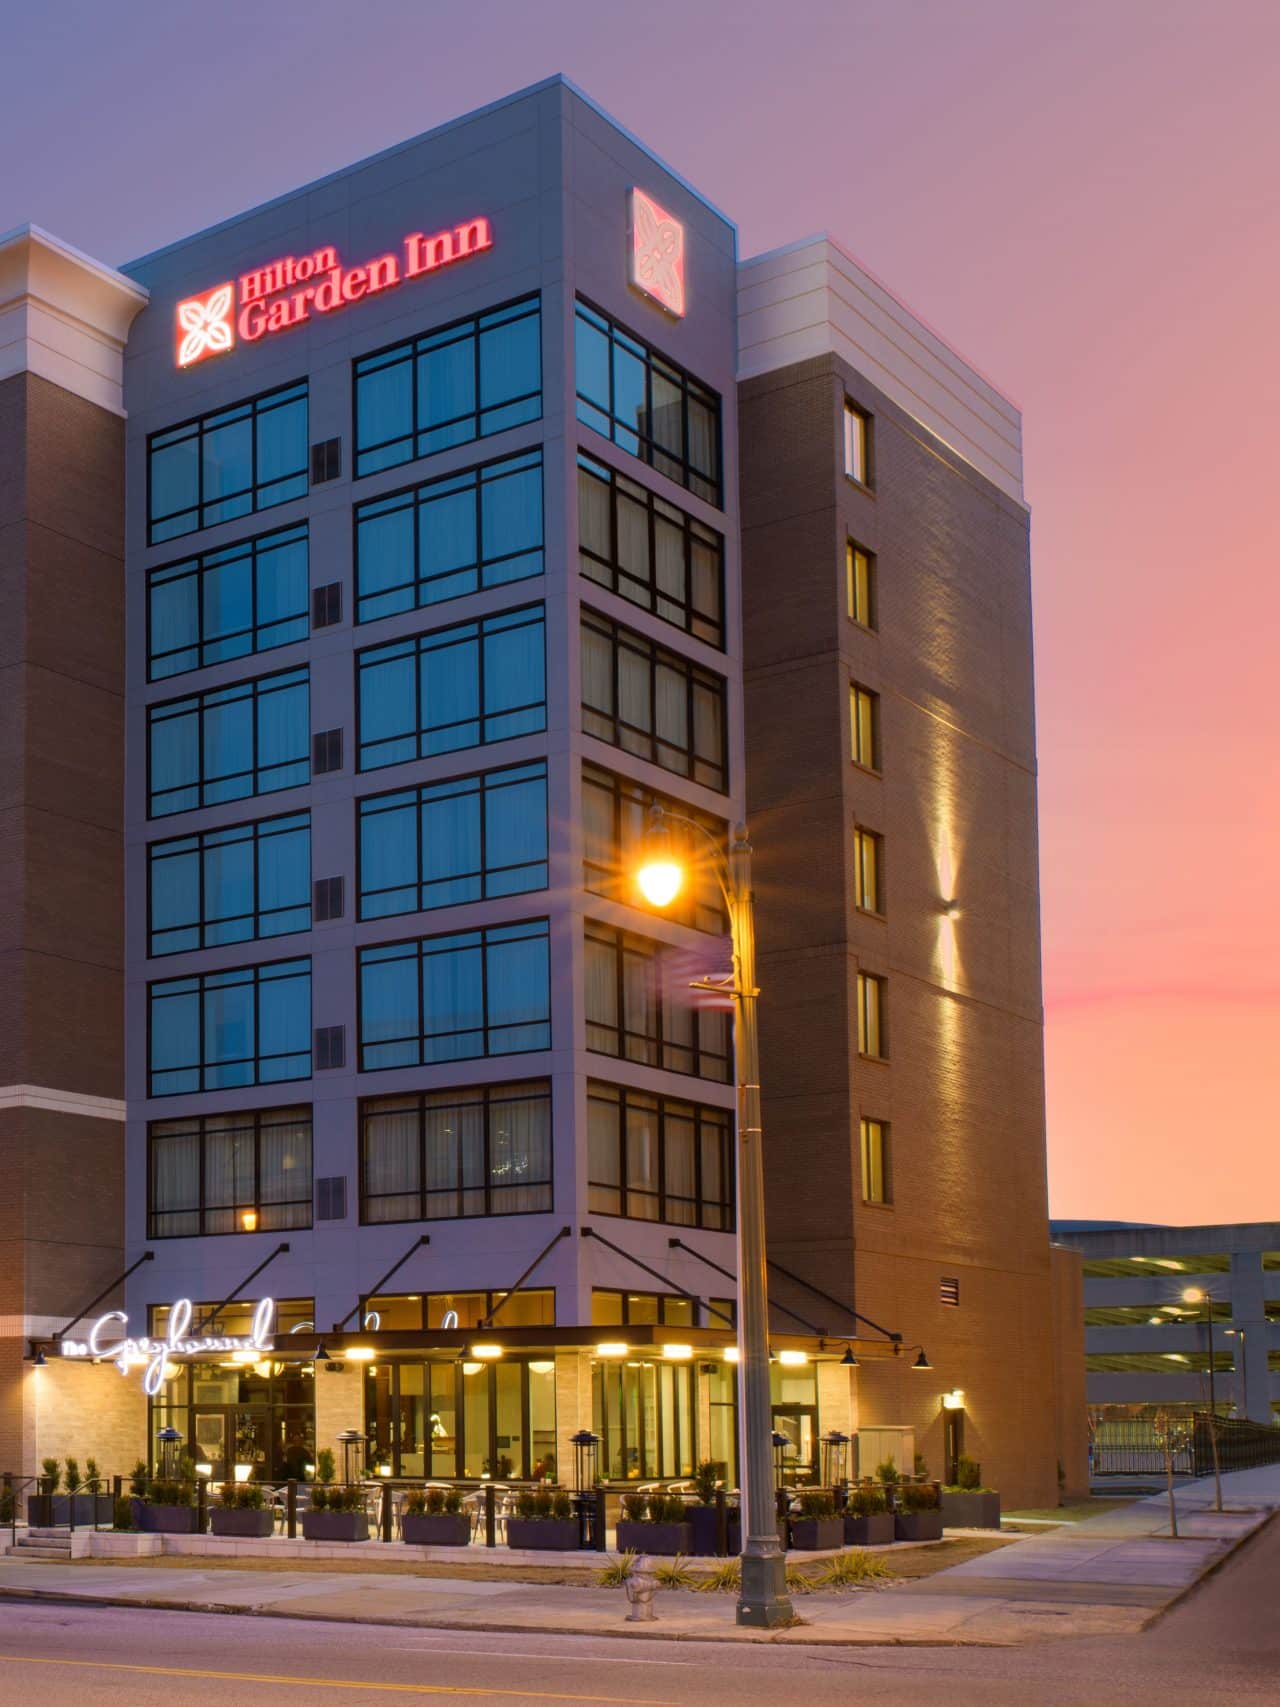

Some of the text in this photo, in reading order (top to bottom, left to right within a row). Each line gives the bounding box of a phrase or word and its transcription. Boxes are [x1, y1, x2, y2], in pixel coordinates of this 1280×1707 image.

[239, 246, 337, 304] Hilton
[239, 216, 493, 341] Garden Inn
[90, 1298, 274, 1395] Greyhound
